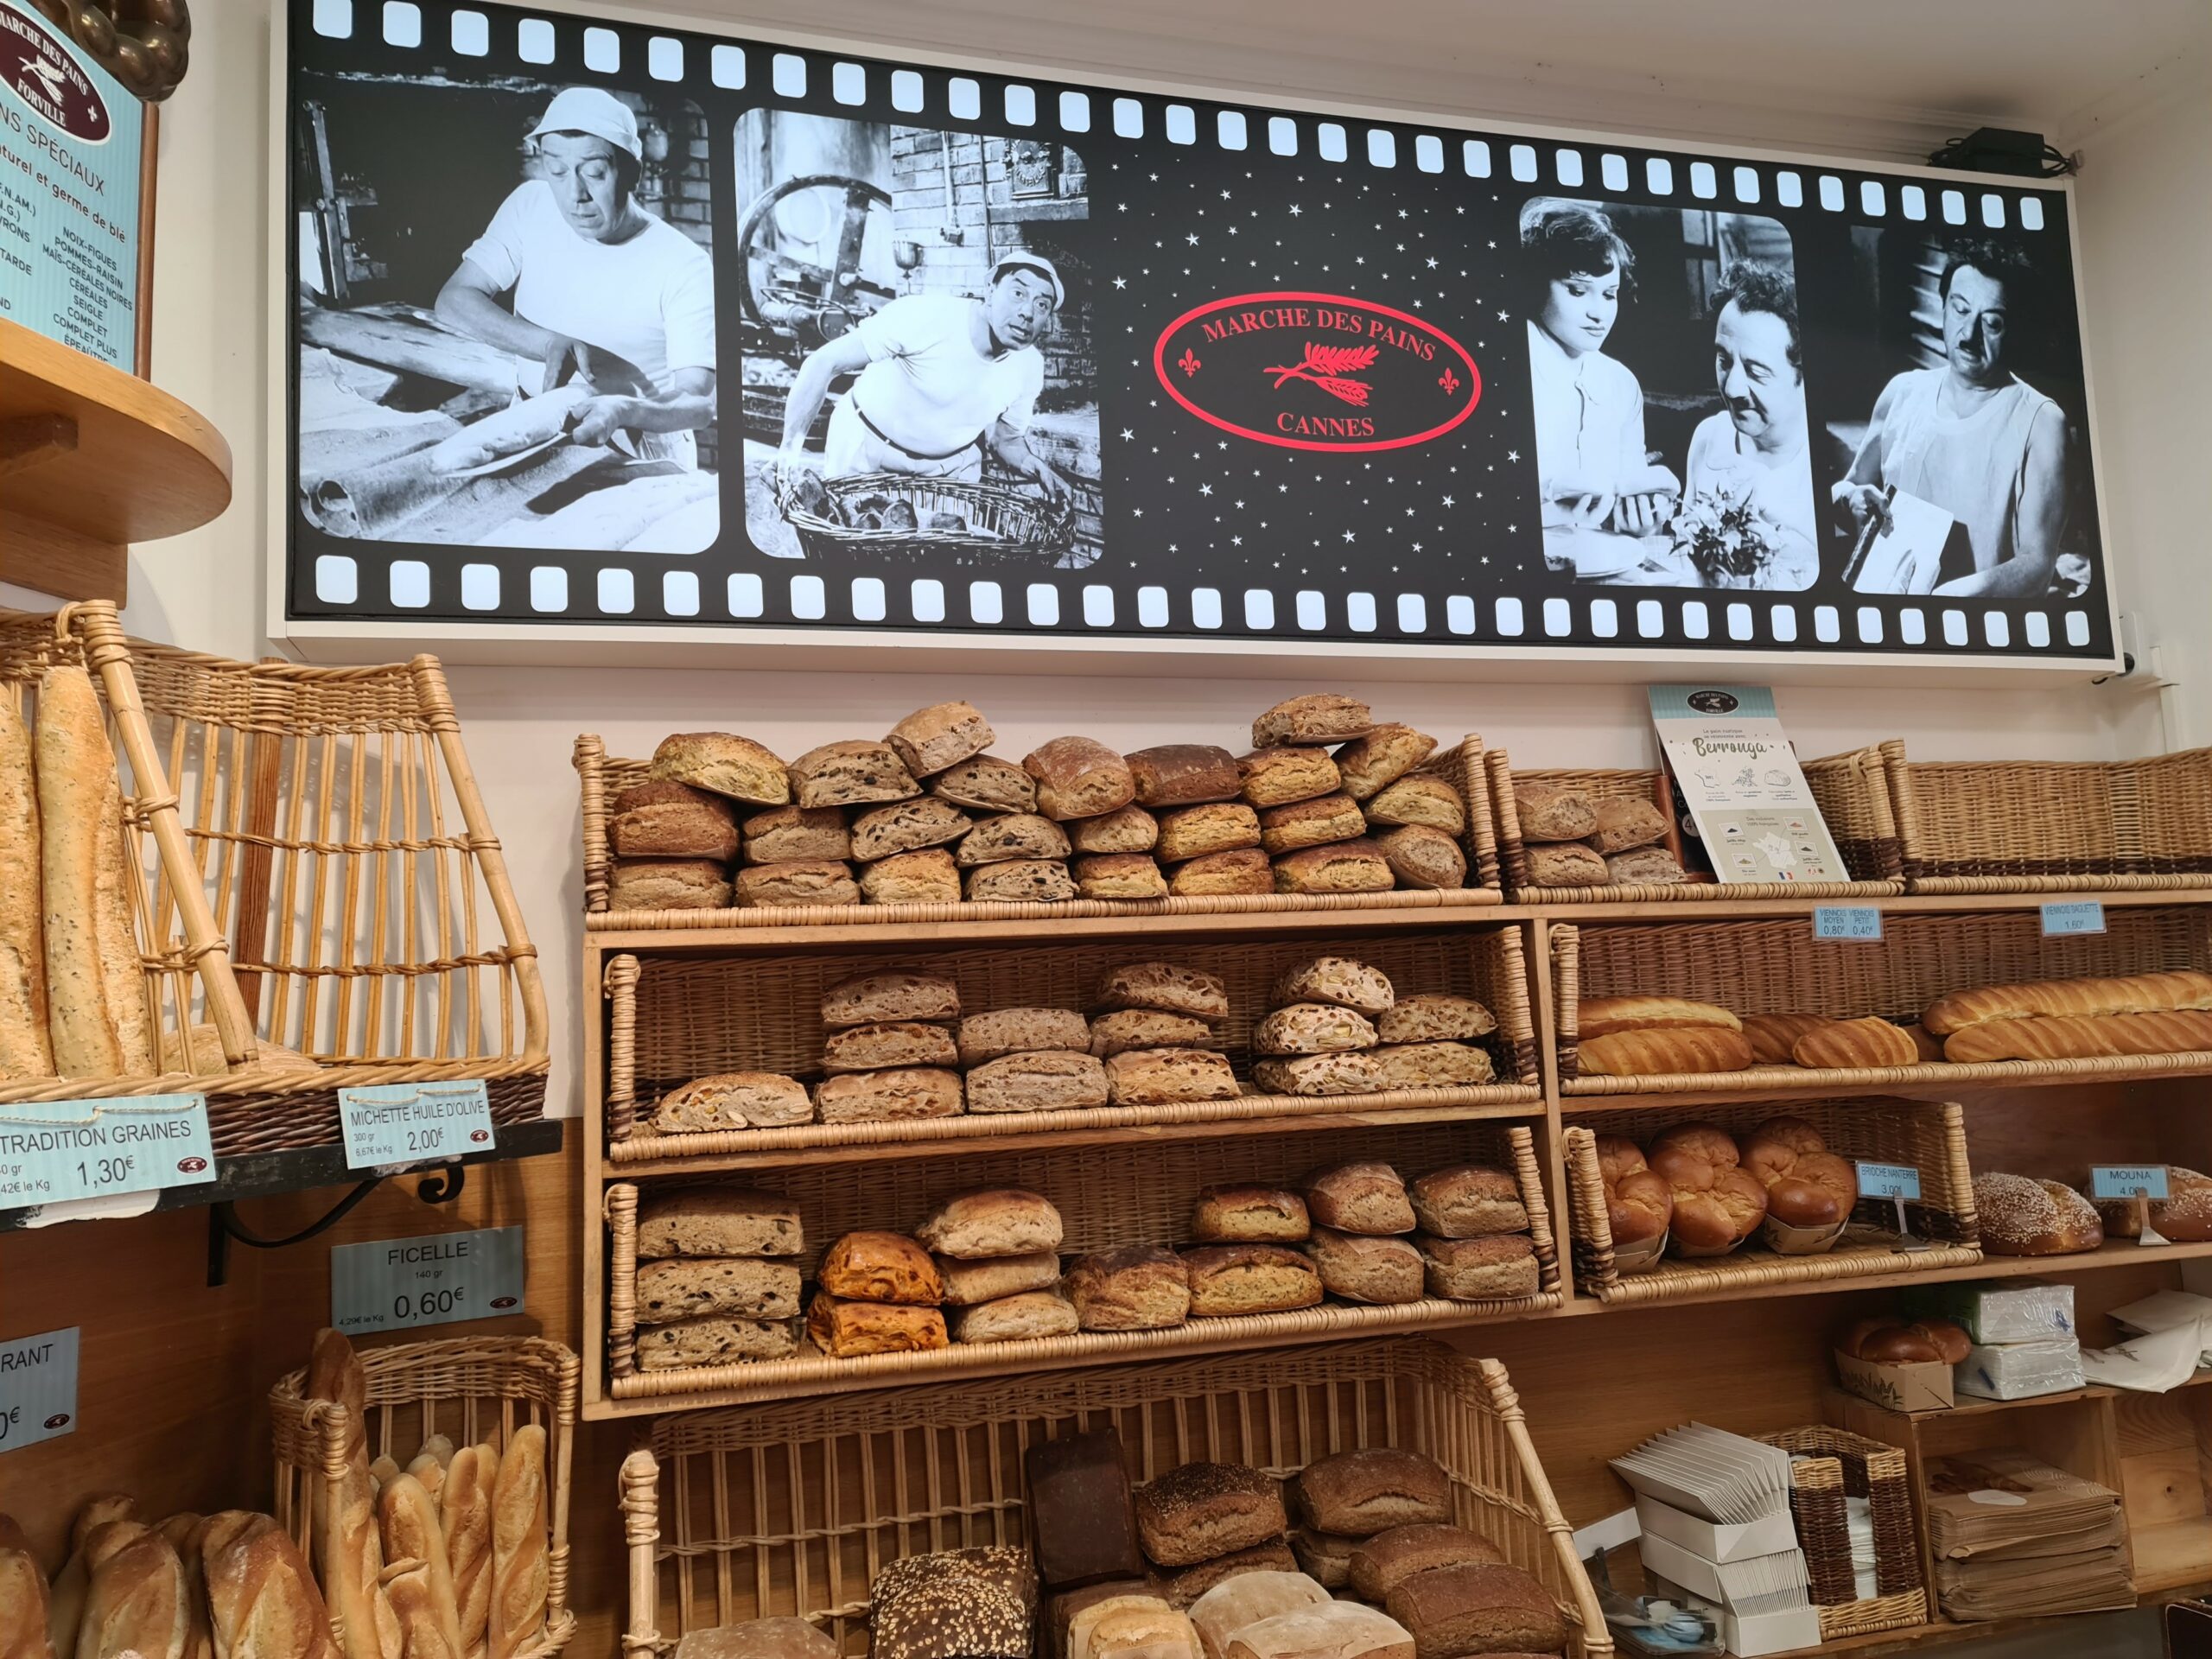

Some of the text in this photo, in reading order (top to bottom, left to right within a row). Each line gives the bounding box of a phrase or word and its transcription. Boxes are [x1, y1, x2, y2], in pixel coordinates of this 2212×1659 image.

[42, 39, 61, 66] DES
[61, 58, 88, 96] PAINS
[18, 78, 67, 127] FORVILLE
[27, 124, 105, 196] SPÉCIAUX
[0, 144, 125, 244] turel et germe de blé
[54, 236, 124, 290] POMMES-RAISIN
[63, 226, 117, 271] NOIX-FIGUES
[69, 276, 108, 309] CÉRÉALES
[73, 295, 103, 321] SEIGLE
[106, 286, 132, 311] NOIRES
[53, 313, 118, 359] COMPLET PLUS
[67, 307, 108, 338] COMPLET
[1201, 308, 1437, 362] MARCHE DES PAINS
[1277, 411, 1376, 437] CANNES
[351, 1100, 485, 1127] MICHETTE HUILE D'OLIVE
[0, 1120, 191, 1155] TRADITION GRAINES
[353, 1133, 375, 1142] 300 gr
[407, 1127, 444, 1154] 2,00€
[11, 1165, 22, 1176] gr
[23, 1181, 33, 1192] le
[35, 1179, 50, 1192] Kg
[77, 1154, 135, 1190] 1,30€
[2109, 1170, 2152, 1180] MOUNA
[388, 1242, 468, 1265] FICELLE
[416, 1269, 442, 1279] 140 gr
[394, 1287, 464, 1320] 0,60€
[1, 1344, 54, 1373] RANT
